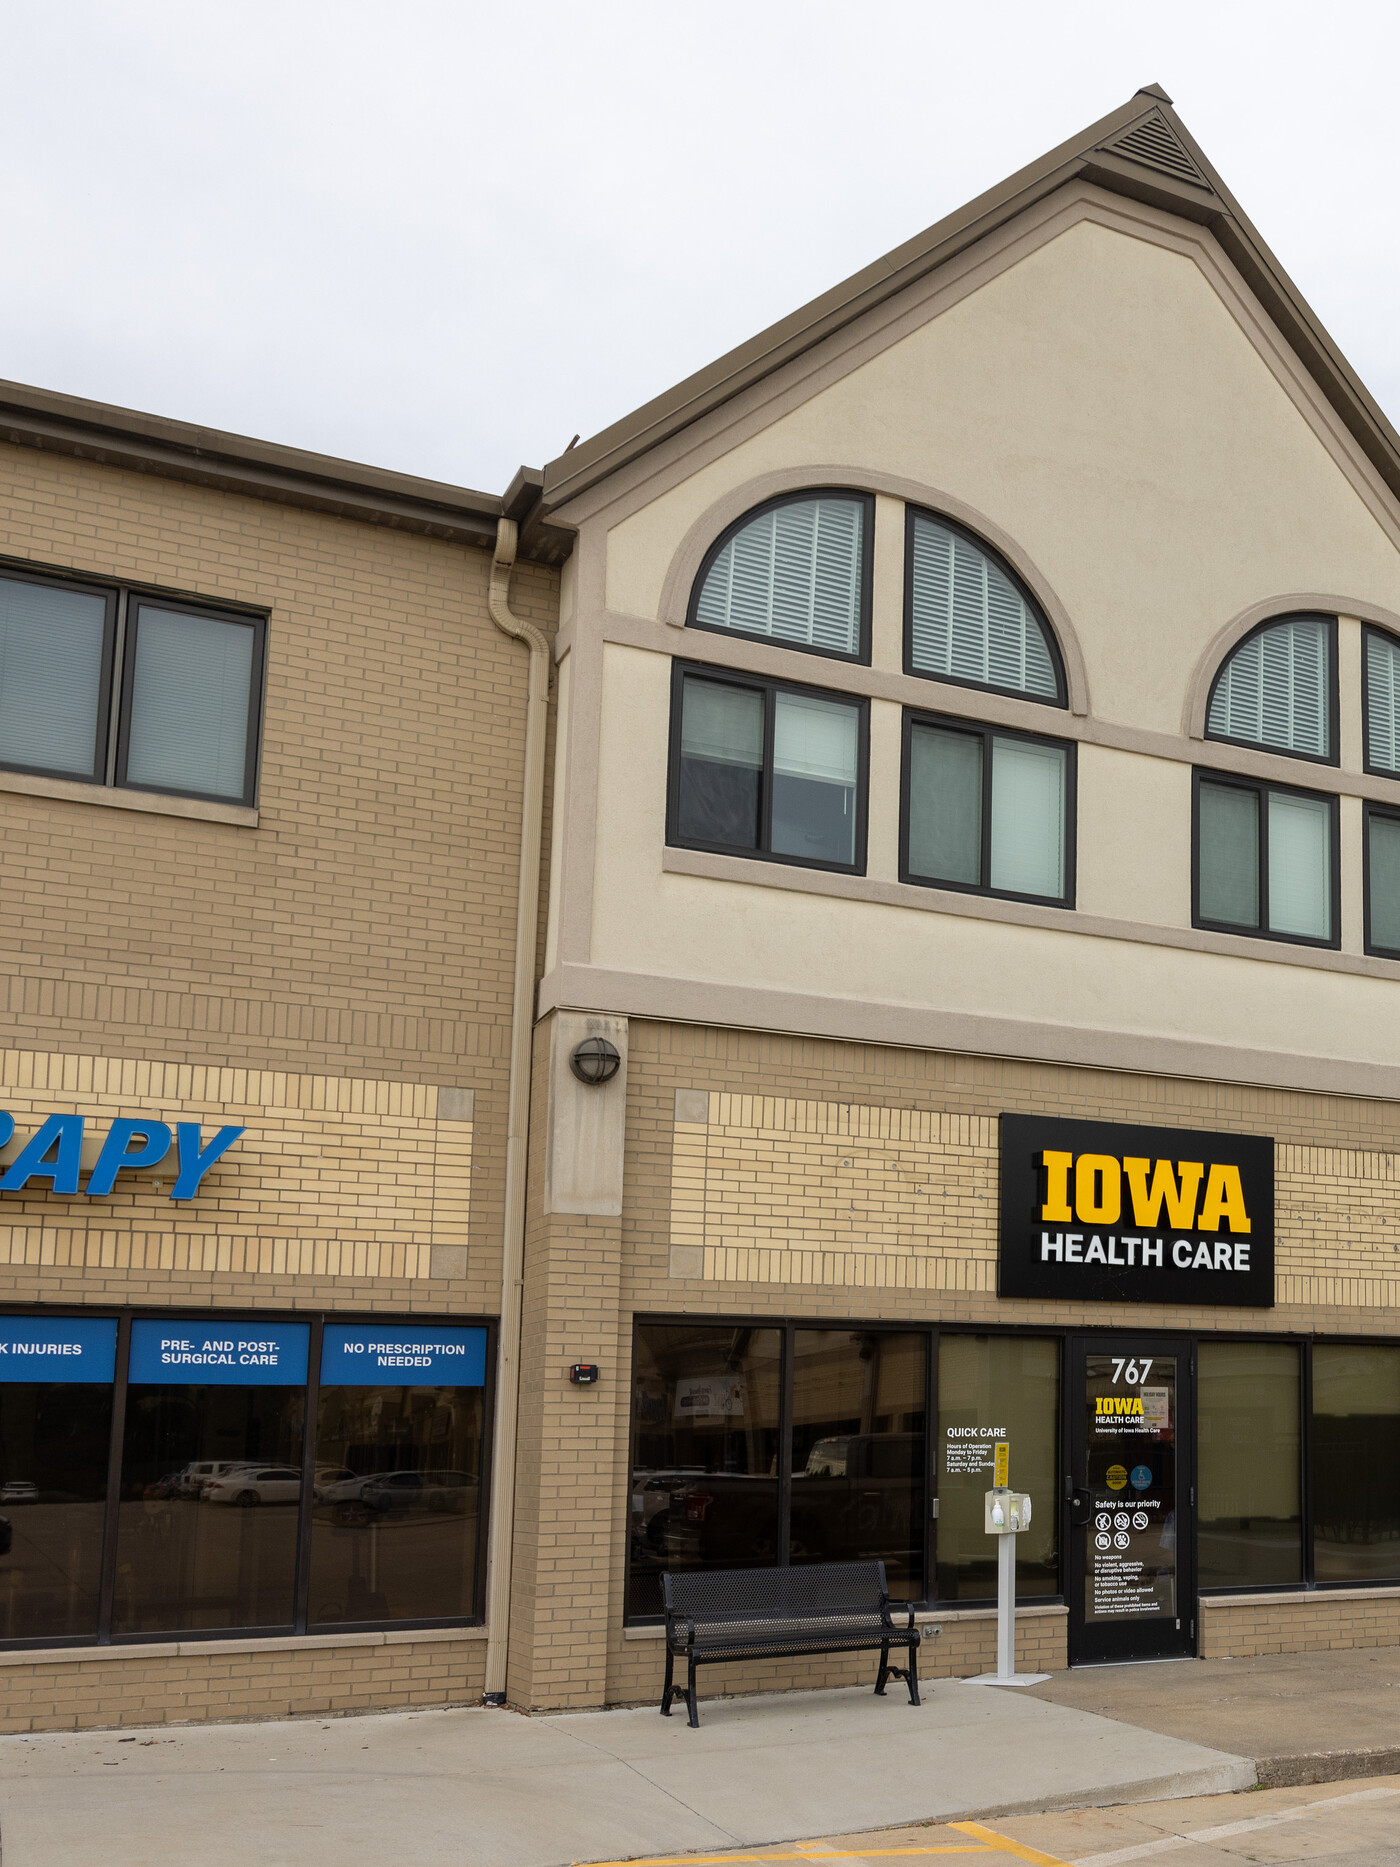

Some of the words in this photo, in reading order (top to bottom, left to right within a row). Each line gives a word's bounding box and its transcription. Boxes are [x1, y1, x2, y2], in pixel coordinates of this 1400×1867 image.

[0, 1110, 248, 1201] APY
[1041, 1150, 1251, 1233] IOWA
[1041, 1231, 1163, 1267] HEALTH
[1172, 1239, 1250, 1271] CARE
[12, 1343, 82, 1355] INJURIES
[161, 1339, 195, 1351] PRE-
[202, 1341, 234, 1352] AND
[238, 1341, 280, 1352] POST-
[344, 1343, 364, 1353] NO
[368, 1343, 465, 1355] PRESCRIPTION
[161, 1353, 236, 1364] SURGICAL
[240, 1354, 278, 1365] CARE
[377, 1356, 432, 1367] NEEDED
[1112, 1358, 1153, 1384] 767
[1096, 1398, 1144, 1414] IOWA
[1096, 1416, 1124, 1424] HEALTH
[1125, 1416, 1144, 1424] CARE
[947, 1428, 978, 1438] QUICK
[980, 1428, 1006, 1437] CARE
[1095, 1501, 1116, 1509] Safety
[1137, 1500, 1161, 1509] priority
